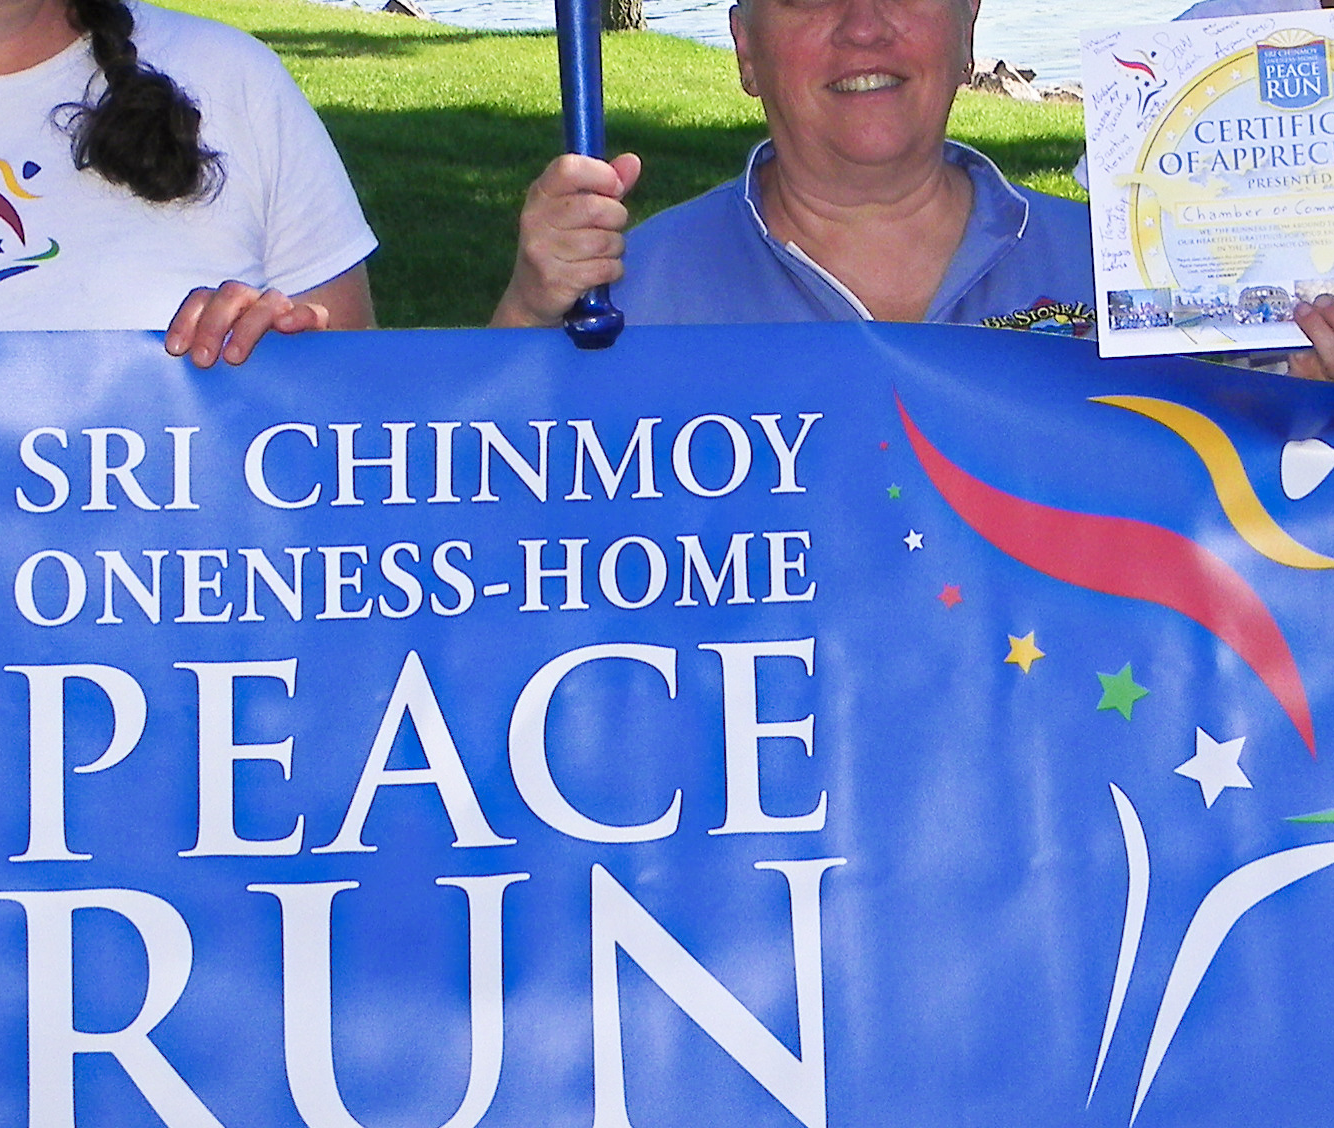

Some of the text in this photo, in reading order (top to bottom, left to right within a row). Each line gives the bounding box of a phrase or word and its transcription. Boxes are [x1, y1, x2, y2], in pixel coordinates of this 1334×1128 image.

[1266, 61, 1320, 79] PEACE
[1267, 76, 1321, 99] RUN
[1159, 150, 1200, 176] OF
[1248, 173, 1333, 189] PRESENTED
[1183, 203, 1263, 222] Chamber
[1014, 303, 1072, 325] STONE
[14, 412, 825, 514] SRI CHINMOY
[13, 529, 820, 627] ONENESS-HOME
[4, 635, 830, 863] PEACE
